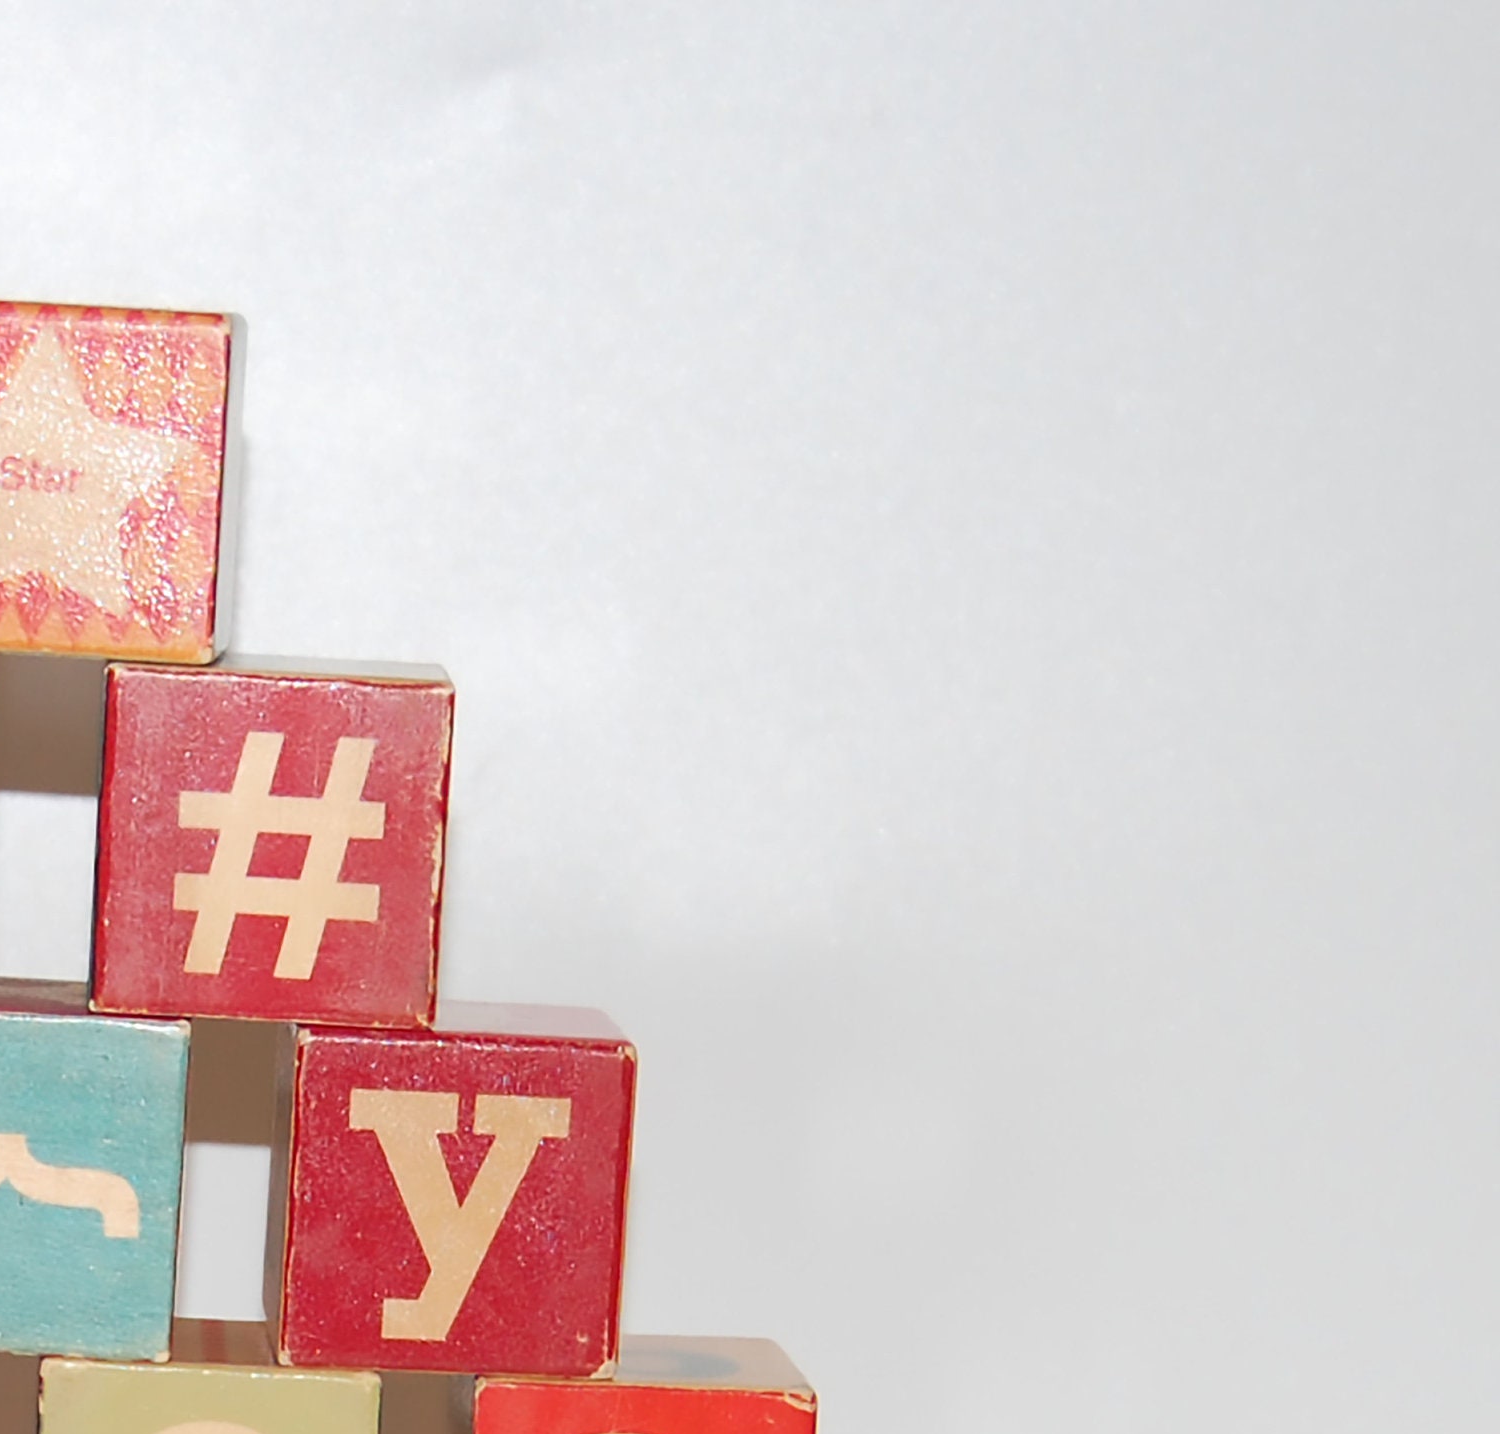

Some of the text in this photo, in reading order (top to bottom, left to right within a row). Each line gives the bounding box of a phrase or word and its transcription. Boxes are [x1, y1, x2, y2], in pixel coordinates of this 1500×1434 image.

[0, 455, 84, 493] Star
[173, 731, 386, 980] #
[348, 1087, 572, 1341] y
